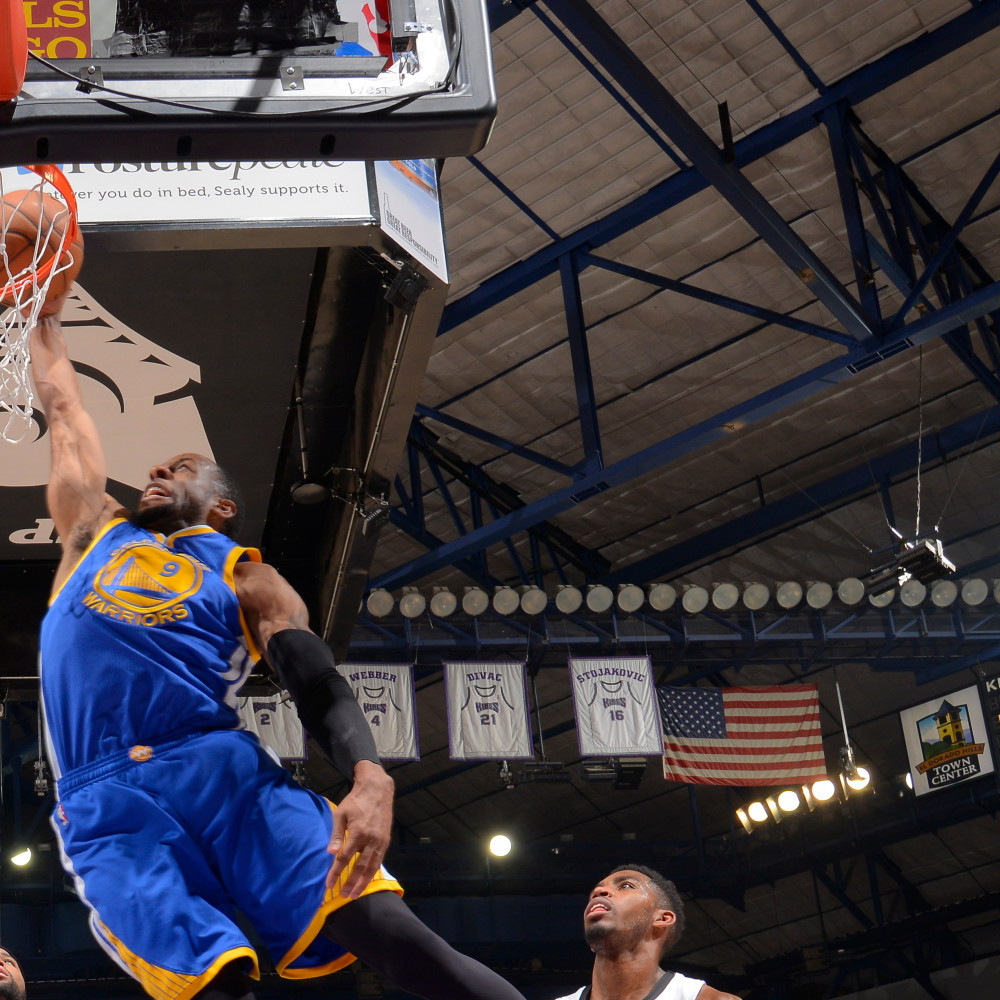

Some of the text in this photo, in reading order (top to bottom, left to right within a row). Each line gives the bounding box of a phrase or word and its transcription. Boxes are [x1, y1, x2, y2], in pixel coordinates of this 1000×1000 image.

[98, 190, 127, 201] you
[133, 188, 152, 198] do
[158, 187, 173, 197] in
[178, 186, 211, 198] bed,
[214, 186, 255, 197] Sealy
[260, 184, 329, 196] supports
[334, 183, 349, 193] it.
[159, 561, 181, 578] 9
[81, 591, 190, 627] WARRIORS
[349, 671, 397, 682] WEBBER
[466, 672, 502, 682] DIVAC
[577, 668, 645, 683] STOJAKOVIC
[260, 714, 270, 725] 2
[371, 715, 380, 726] 4
[480, 714, 496, 725] 21
[609, 710, 624, 721] 16
[928, 751, 961, 766] DORADO
[962, 745, 983, 756] HILLS
[932, 757, 971, 776] TOWN
[931, 764, 978, 785] CENTER
